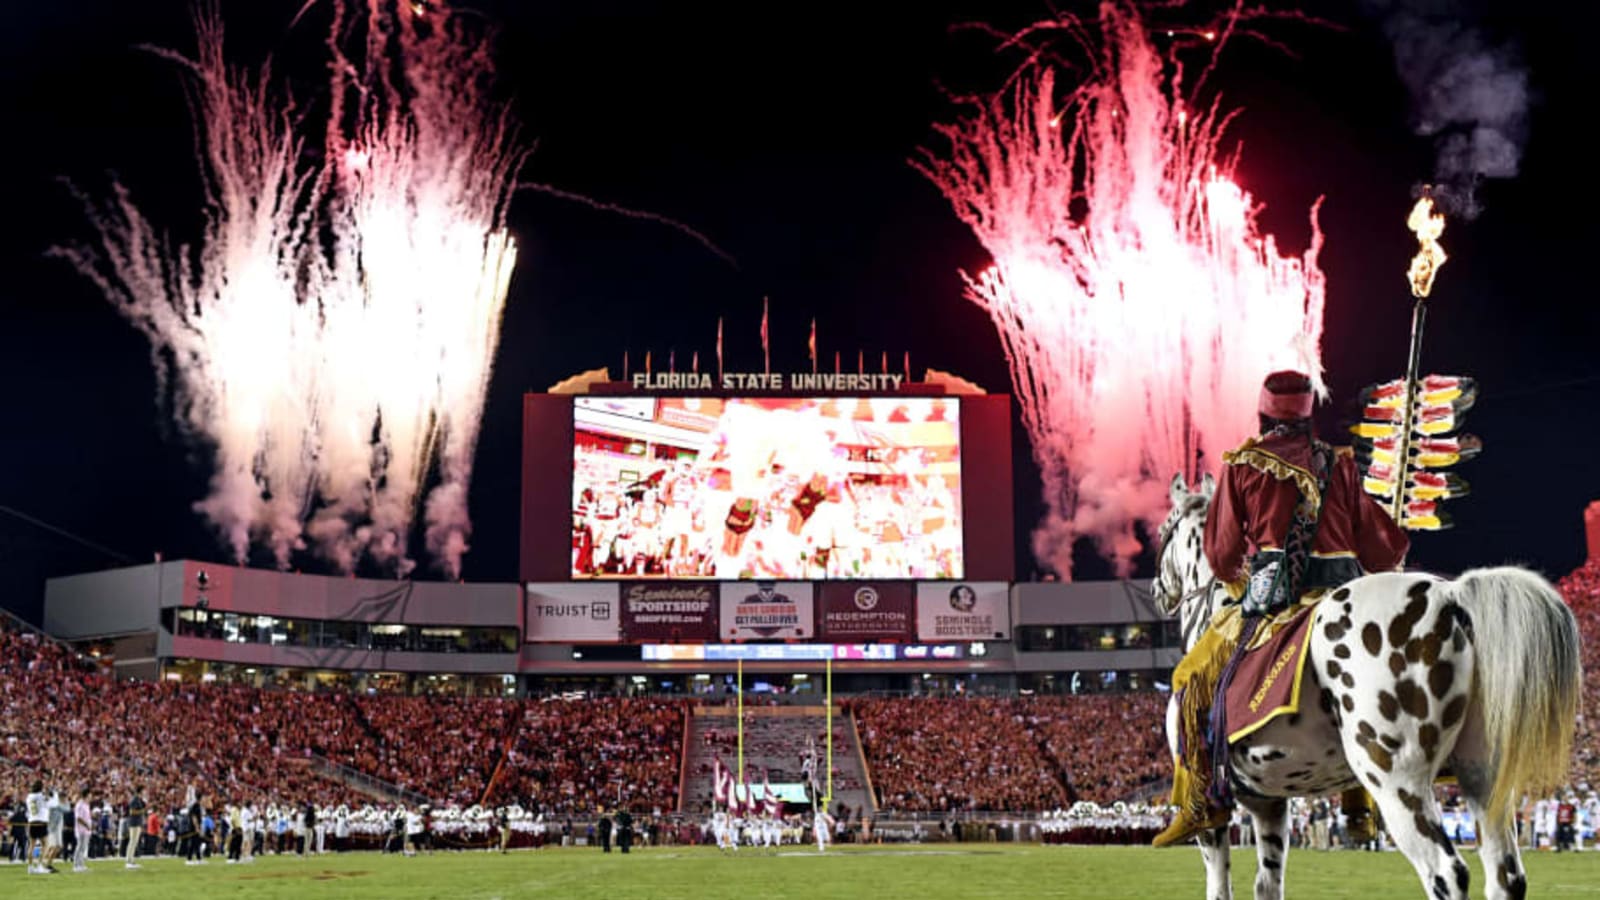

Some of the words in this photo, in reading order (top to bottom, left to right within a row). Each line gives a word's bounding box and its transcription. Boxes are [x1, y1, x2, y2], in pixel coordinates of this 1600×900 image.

[633, 373, 712, 389] FLORIDA
[722, 373, 783, 389] STATE
[791, 373, 903, 390] UNIVERSITY
[536, 604, 588, 617] TRUIST
[827, 612, 906, 621] REDEMPTION
[935, 616, 993, 626] SEMINOLE
[935, 626, 993, 637] BOOSTERS
